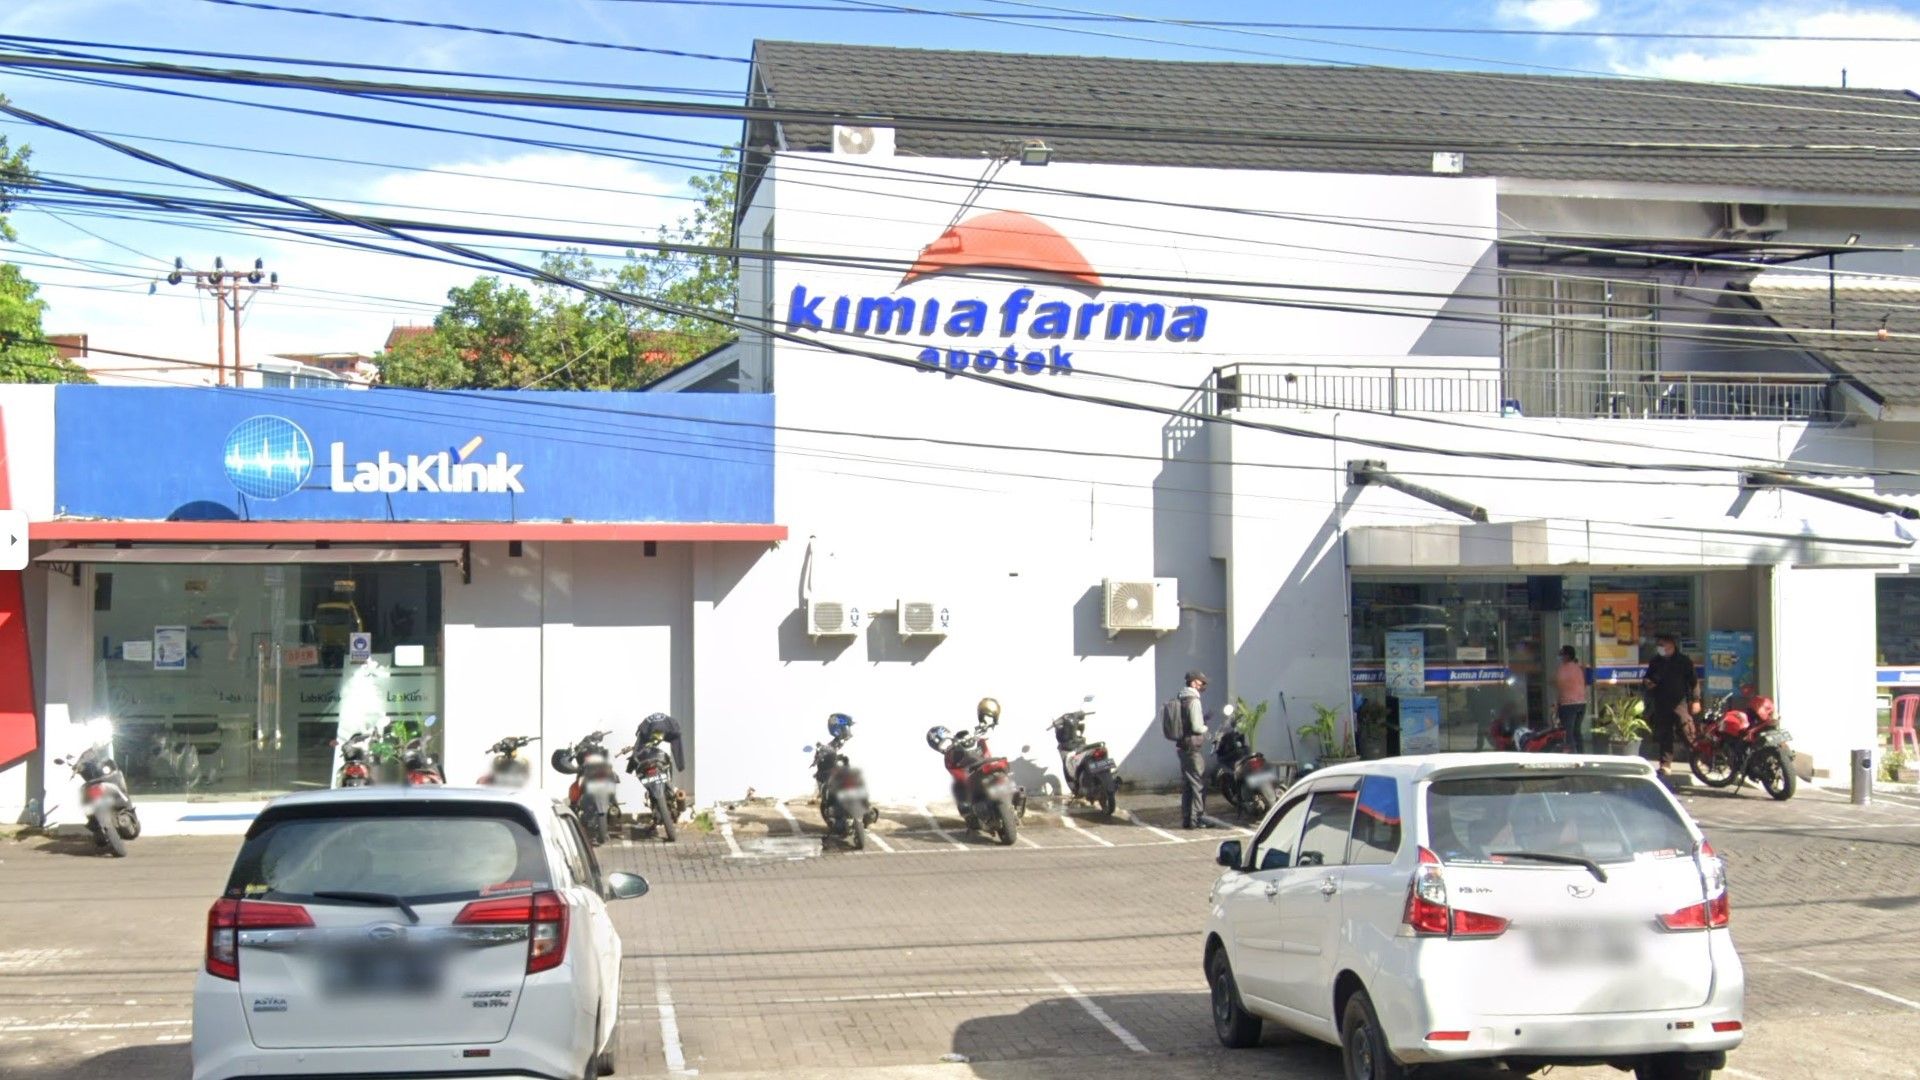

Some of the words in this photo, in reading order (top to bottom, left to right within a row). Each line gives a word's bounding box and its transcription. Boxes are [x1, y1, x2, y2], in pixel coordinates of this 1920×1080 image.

[788, 285, 988, 338] kimia
[1001, 288, 1209, 342] farma
[914, 343, 1074, 379] apotek
[330, 437, 526, 494] LabKlinik
